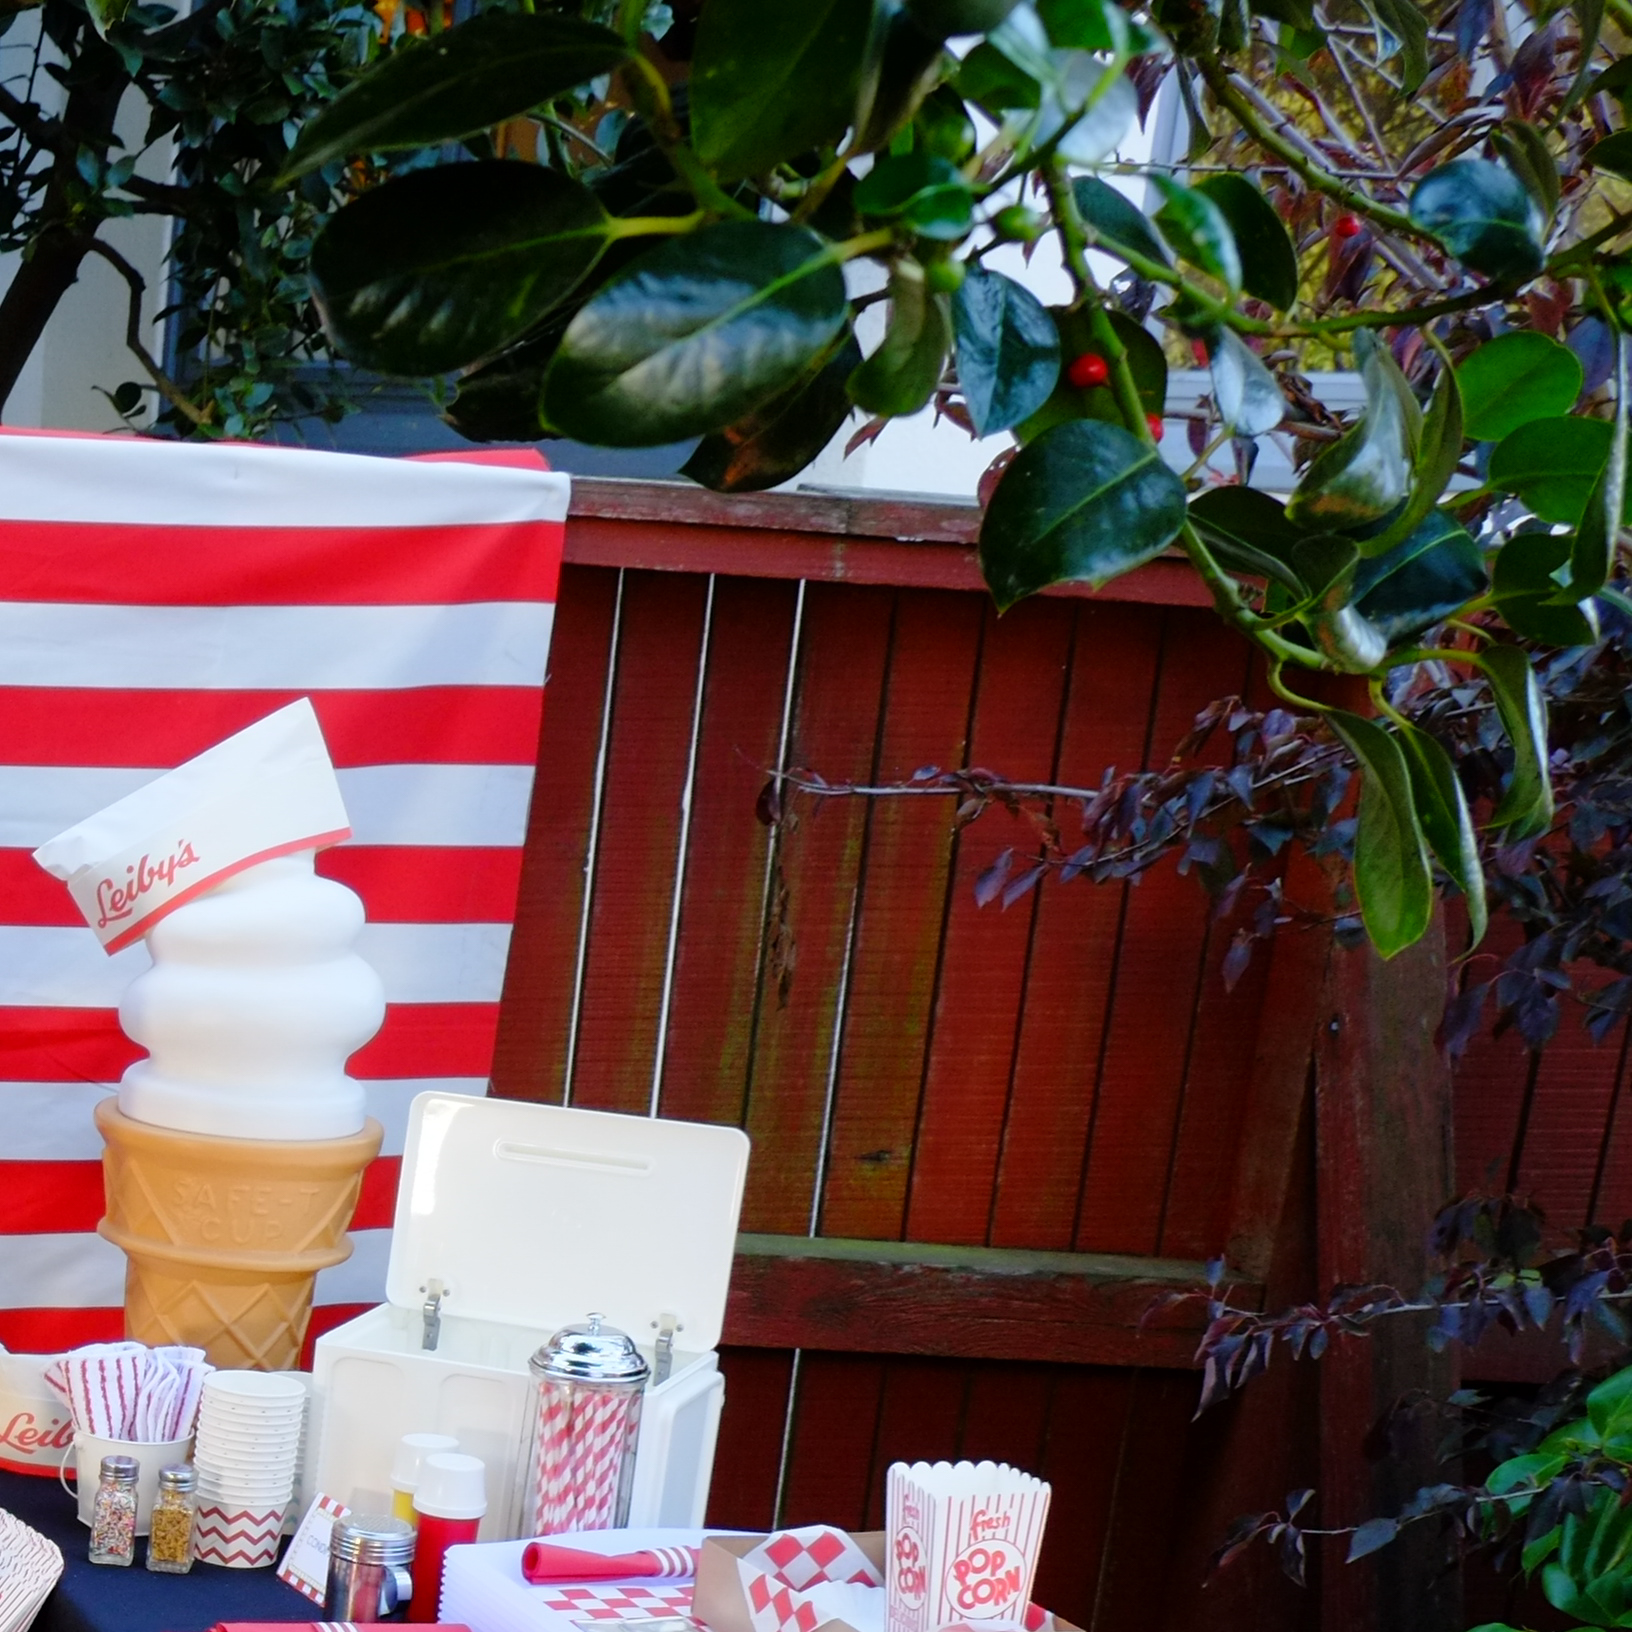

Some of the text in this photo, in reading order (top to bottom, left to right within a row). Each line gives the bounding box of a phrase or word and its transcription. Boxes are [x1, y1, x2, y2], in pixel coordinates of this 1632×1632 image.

[97, 839, 200, 929] Leiby's
[173, 1178, 320, 1215] SAFE-T
[200, 1219, 284, 1244] CUP
[970, 1509, 1011, 1541] fresh
[896, 1533, 919, 1568] POP
[954, 1548, 1006, 1587] POP
[957, 1566, 1021, 1610] CORN
